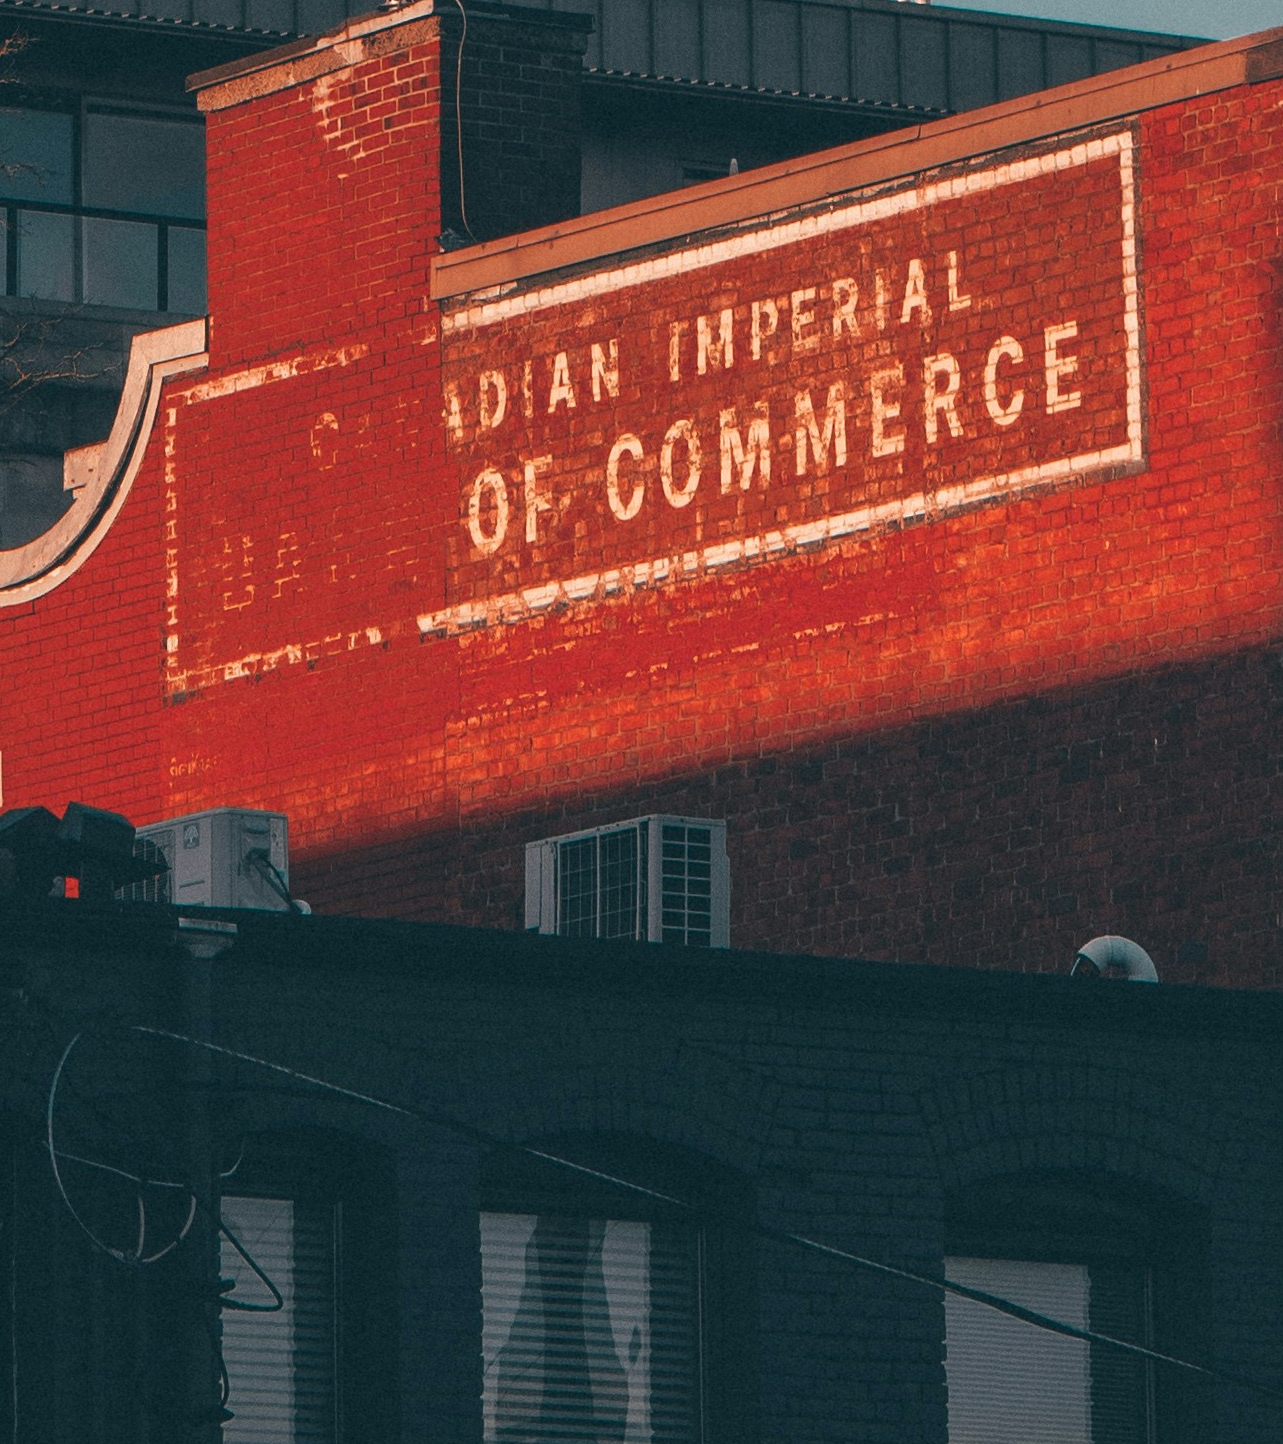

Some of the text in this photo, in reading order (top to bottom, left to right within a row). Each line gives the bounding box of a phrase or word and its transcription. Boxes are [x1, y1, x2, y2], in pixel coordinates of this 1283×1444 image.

[668, 250, 972, 382] IMPERIAL
[468, 320, 1082, 554] OF COMMERCE
